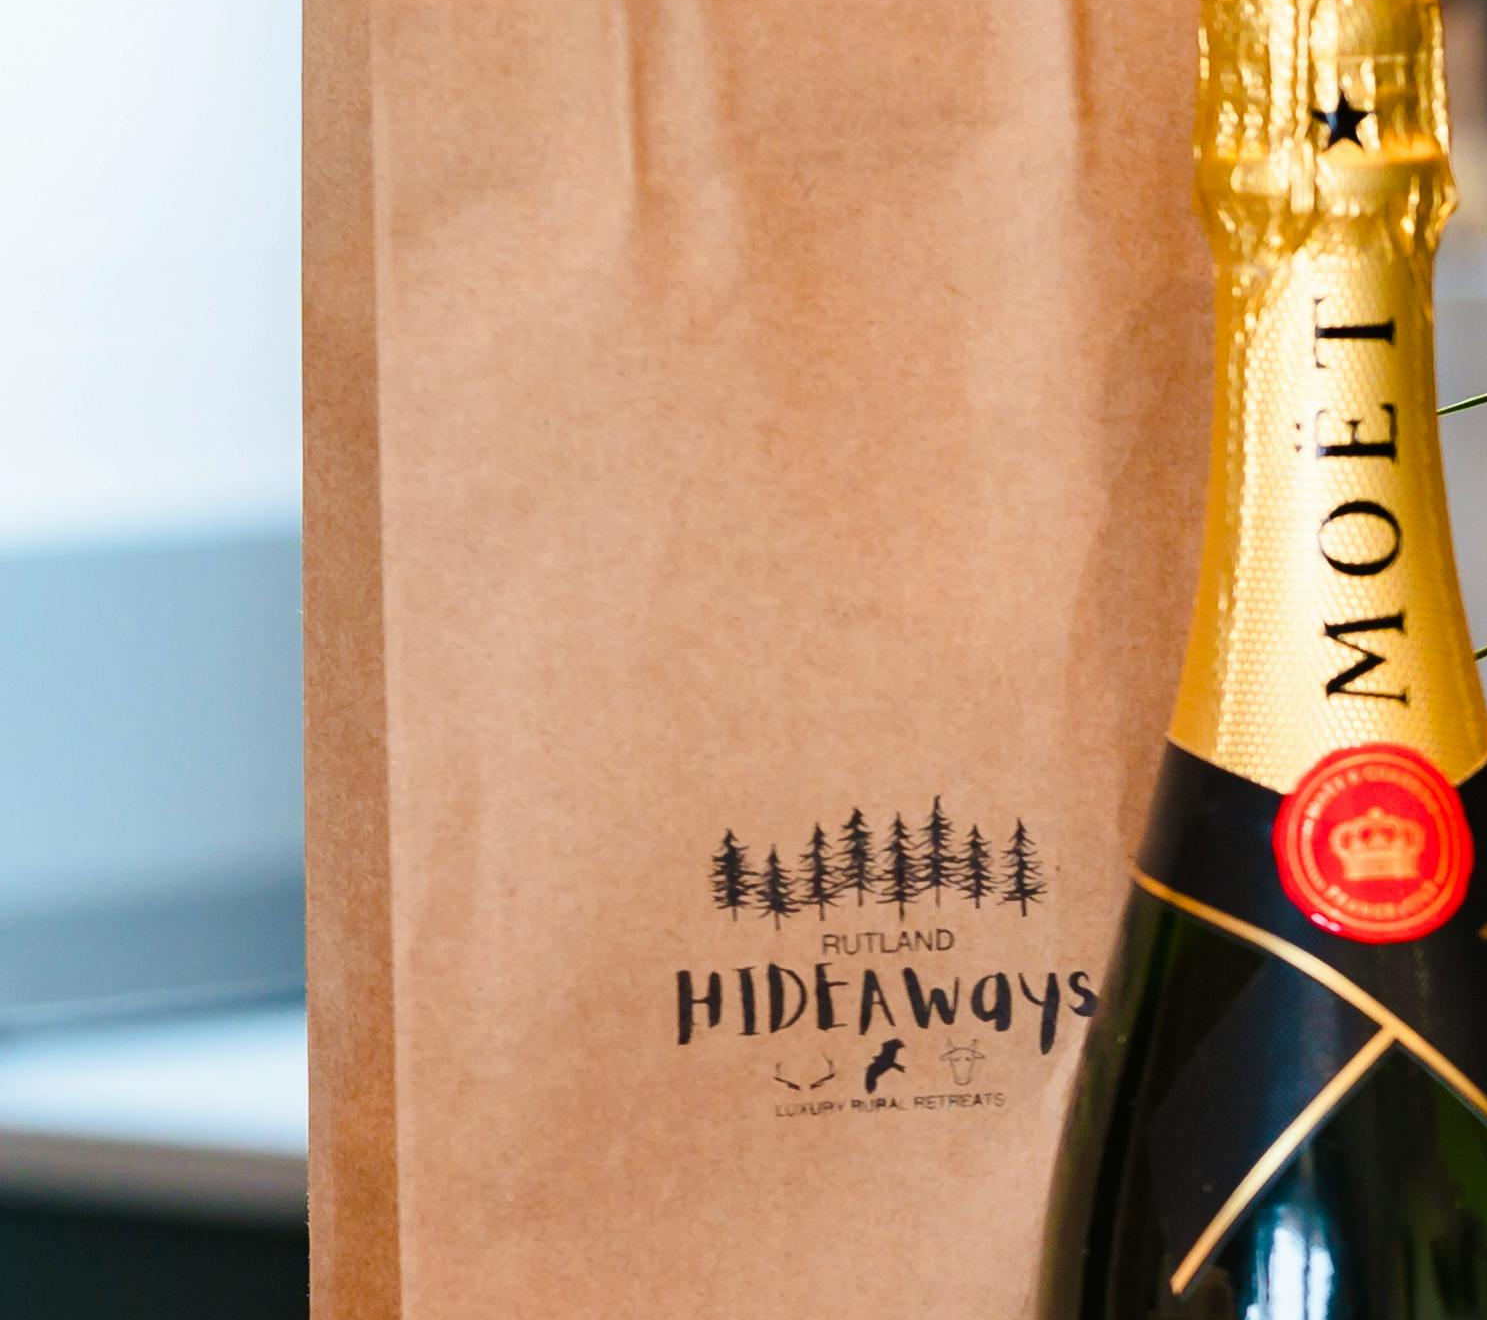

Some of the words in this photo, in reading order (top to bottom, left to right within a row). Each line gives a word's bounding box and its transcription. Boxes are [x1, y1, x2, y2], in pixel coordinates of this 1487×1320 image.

[1294, 297, 1410, 705] MOËT
[822, 929, 955, 954] RUTLAND
[774, 1101, 844, 1118] LUXURY
[913, 1092, 1006, 1110] RETREATS
